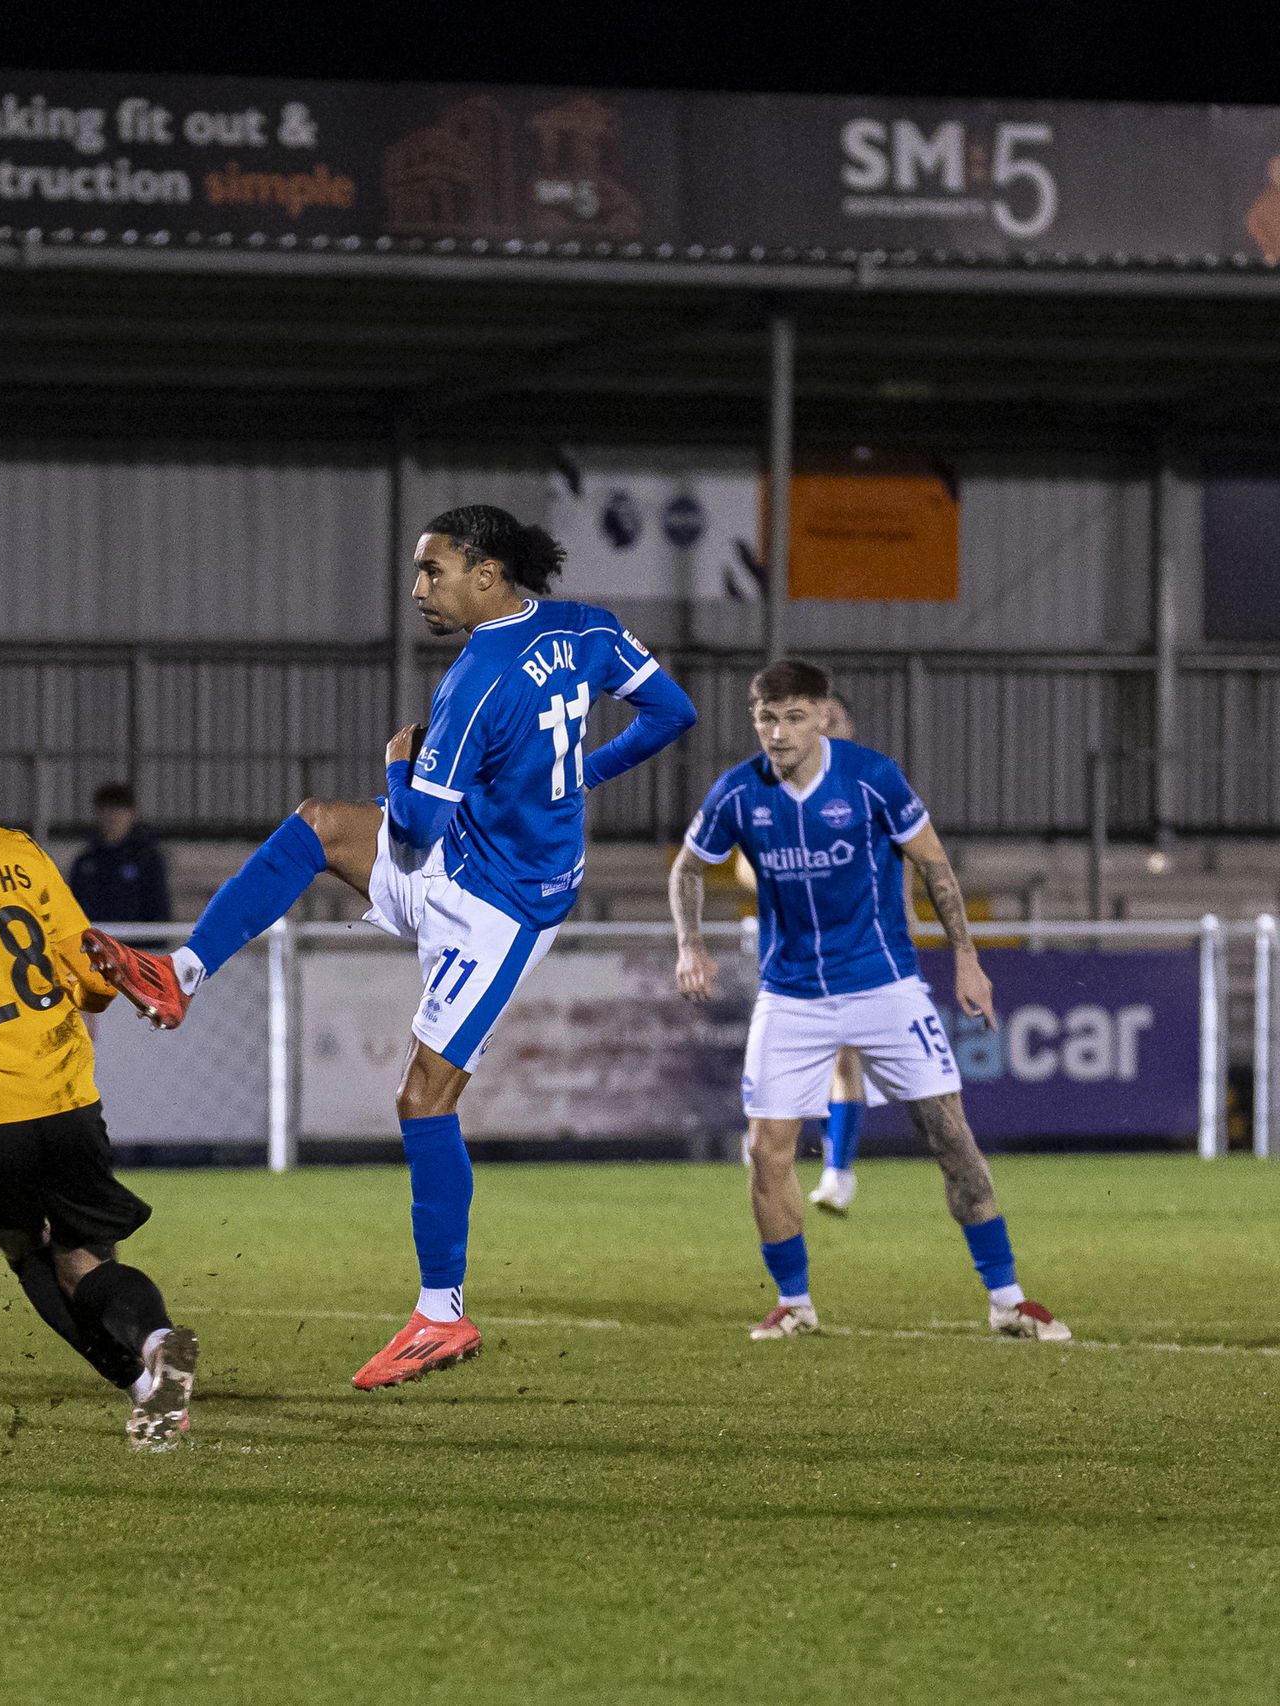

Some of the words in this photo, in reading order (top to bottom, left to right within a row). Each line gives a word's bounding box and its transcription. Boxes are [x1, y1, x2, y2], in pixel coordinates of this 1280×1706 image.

[116, 97, 174, 144] fit
[183, 108, 267, 147] out
[277, 101, 318, 148] &
[203, 161, 356, 217] simple
[539, 681, 590, 801] 11
[429, 947, 478, 1005] 11
[908, 1015, 947, 1057] 15
[952, 1003, 1153, 1082] acar
